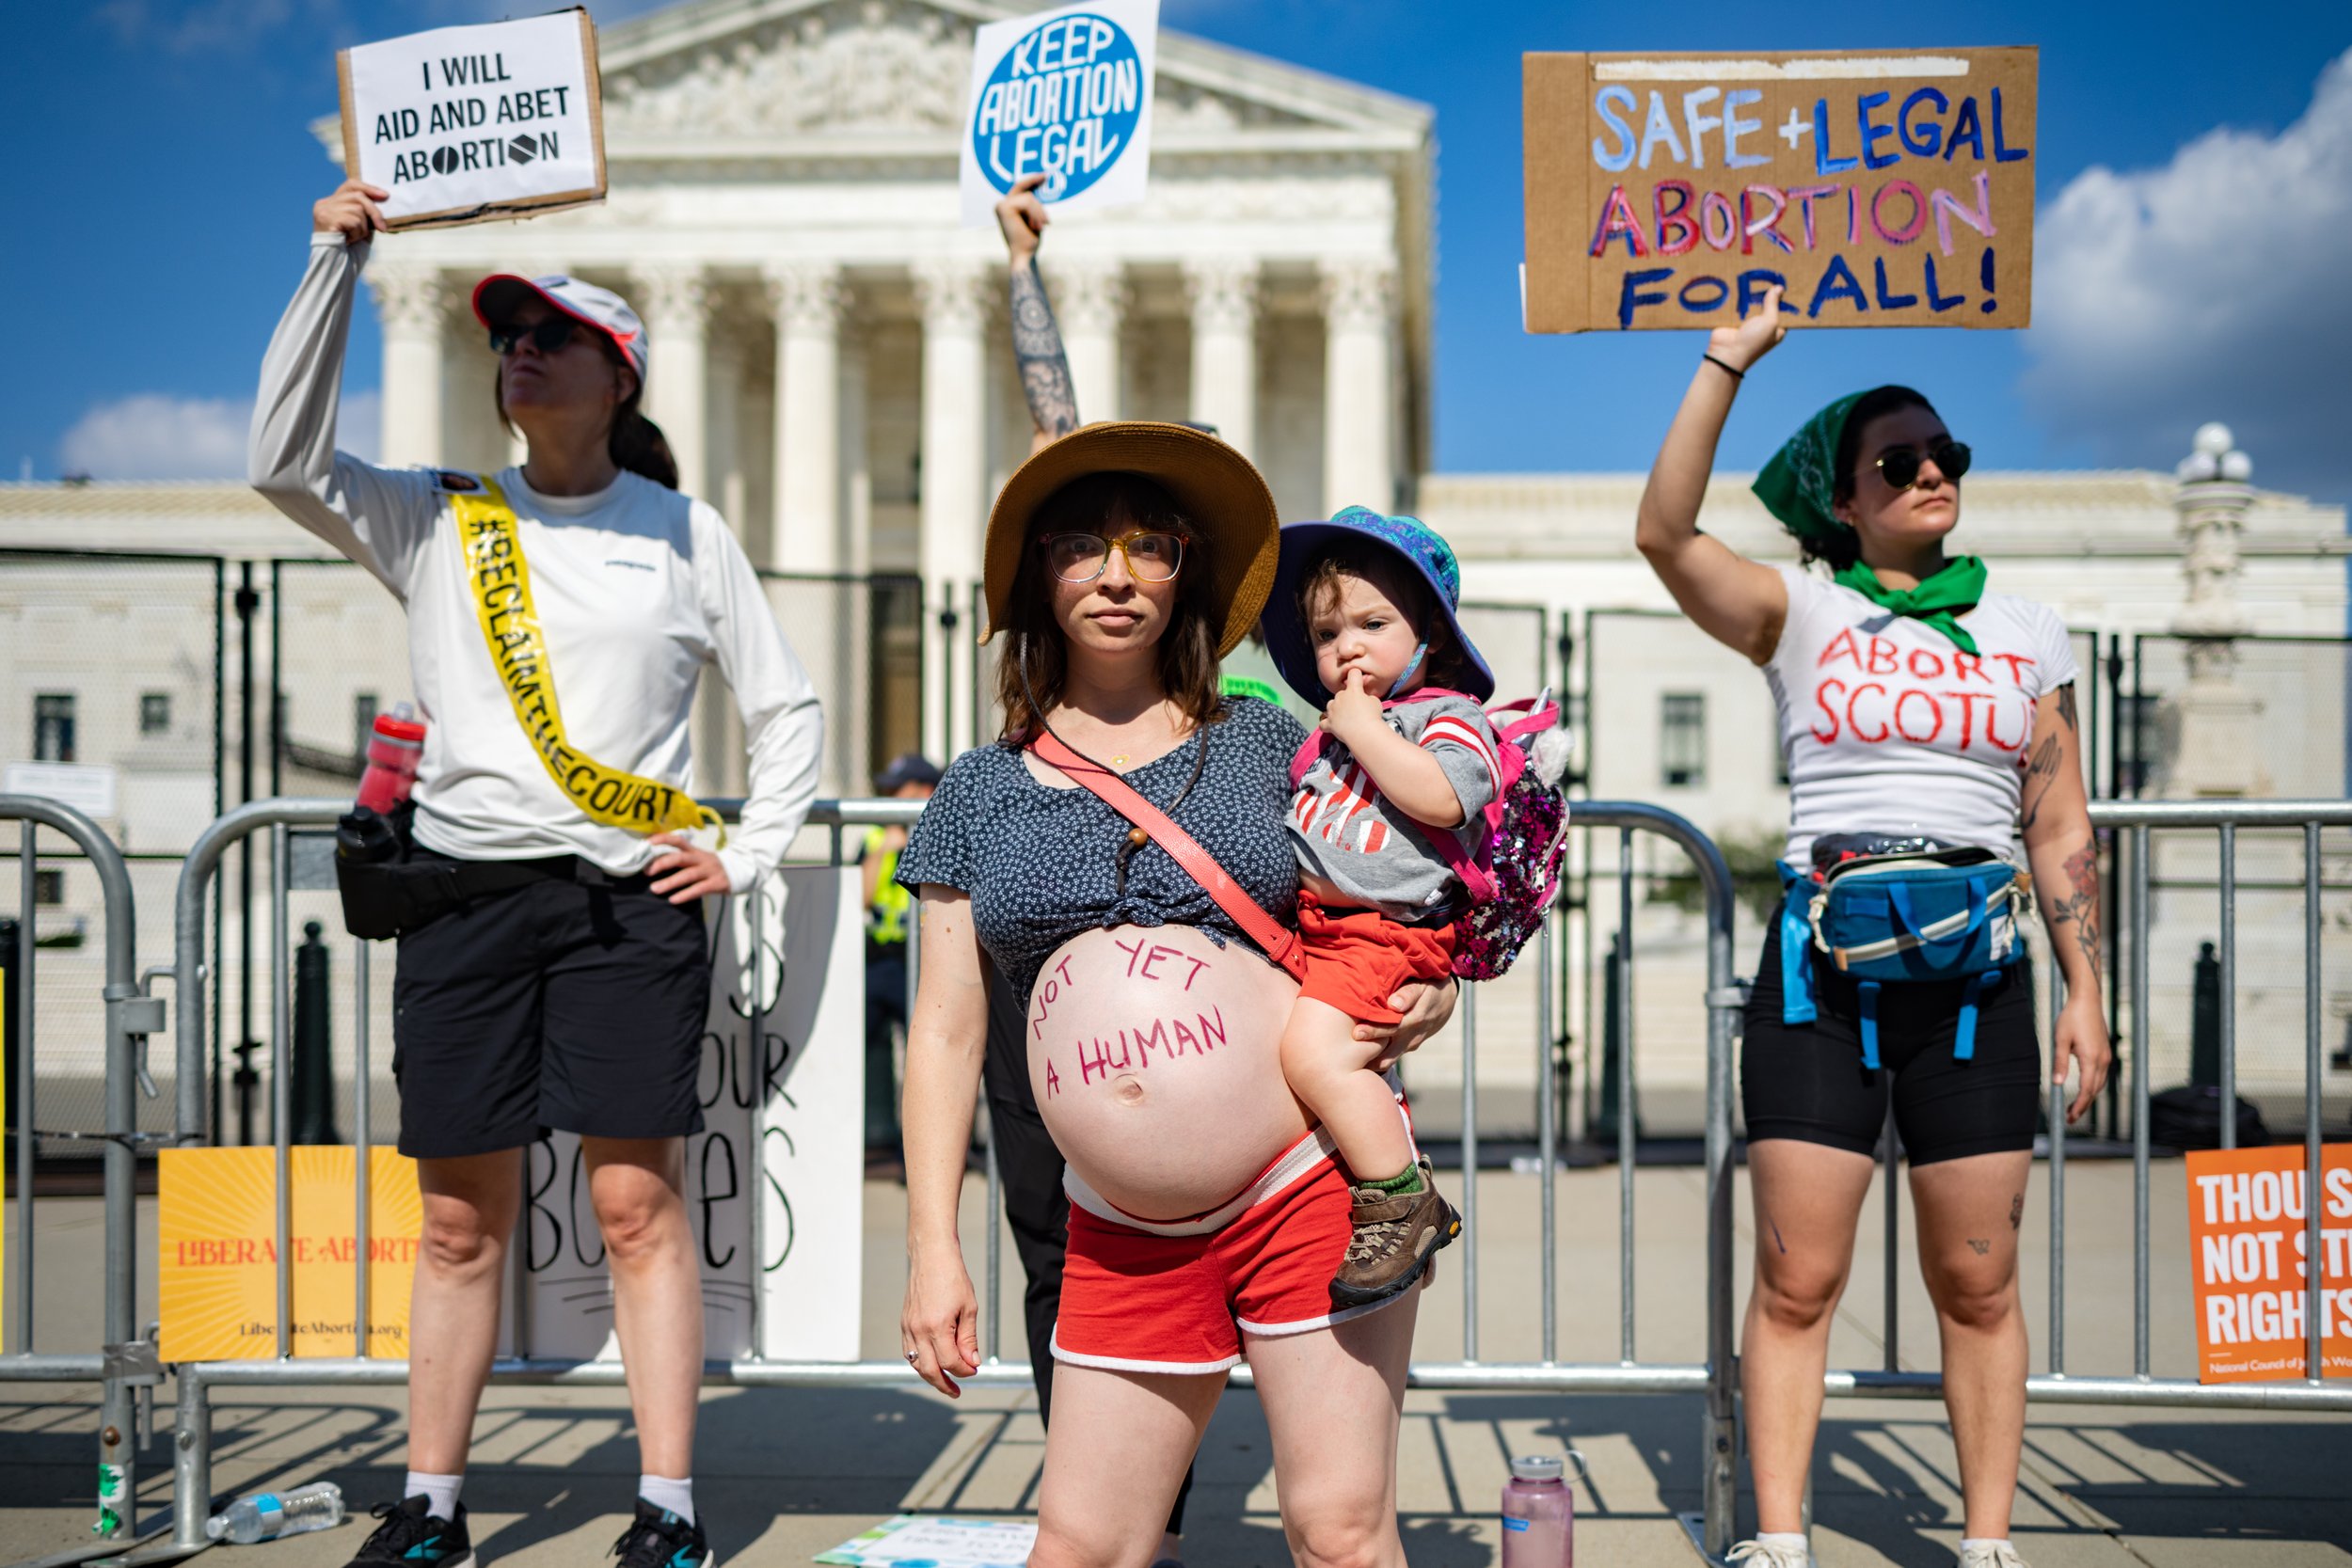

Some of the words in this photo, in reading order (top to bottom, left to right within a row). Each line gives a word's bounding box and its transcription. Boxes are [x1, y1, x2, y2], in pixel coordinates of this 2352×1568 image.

[422, 62, 431, 90] I
[441, 53, 512, 87] WILL
[1011, 17, 1115, 78] KEEP
[374, 108, 420, 145] AID
[429, 98, 486, 135] AND
[497, 86, 569, 124] ABET
[978, 58, 1137, 136] ABORTION
[393, 131, 561, 184] ABORTION
[990, 118, 1120, 188] LEGAL
[1592, 84, 1772, 171] SAFE
[1813, 86, 2029, 177] LEGAL
[1587, 168, 1998, 260] ABORTION
[1617, 267, 1799, 329] FOR
[1807, 246, 1997, 319] ALL!
[1817, 626, 2036, 687] ABORT
[1033, 954, 1073, 1040] NOT
[1115, 938, 1211, 990] YET
[1047, 1056, 1059, 1100] A
[1077, 1004, 1227, 1085] HUMAN
[2196, 1169, 2308, 1225] THOU
[2201, 1230, 2283, 1285] NOT
